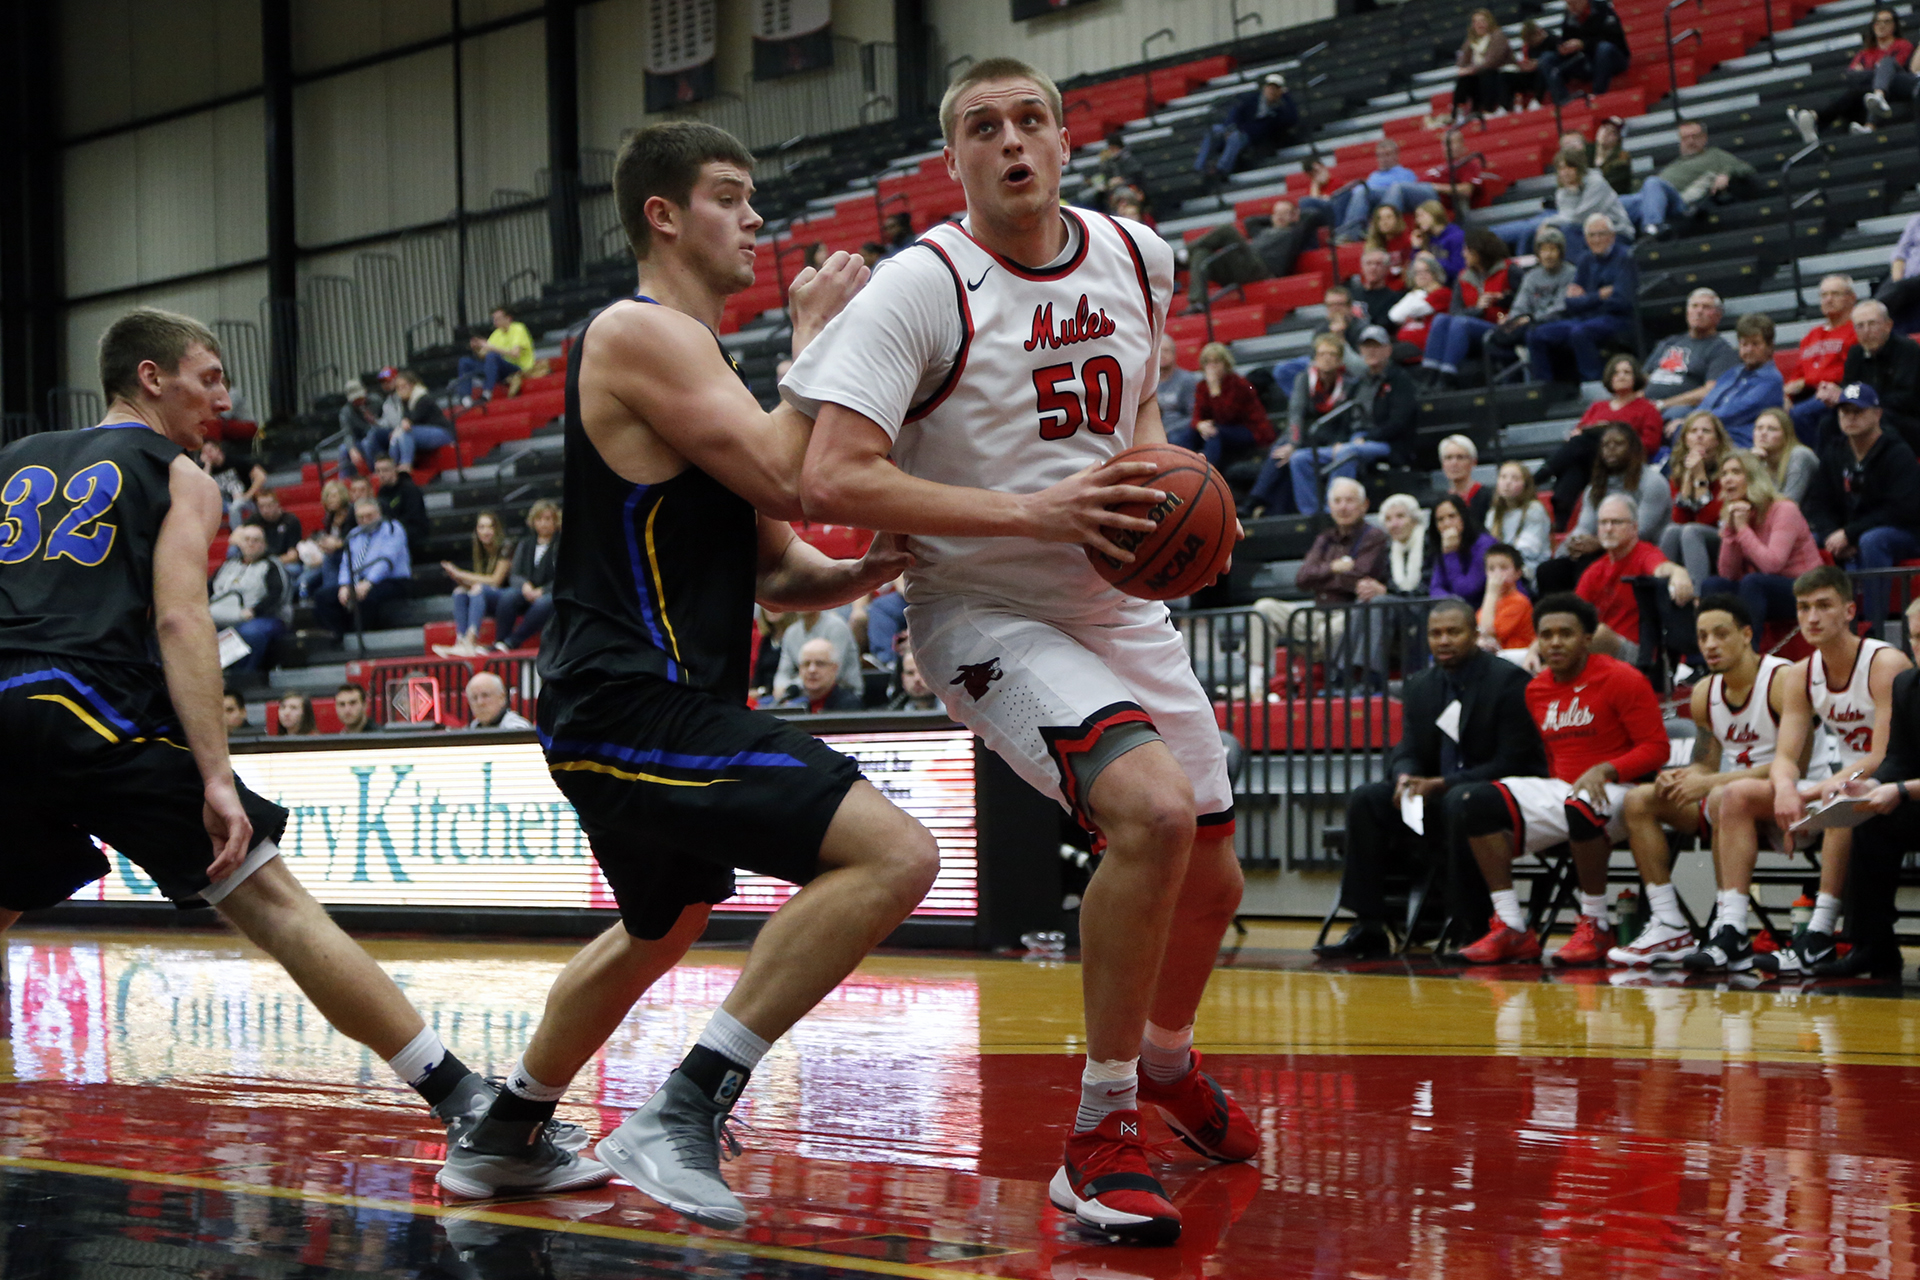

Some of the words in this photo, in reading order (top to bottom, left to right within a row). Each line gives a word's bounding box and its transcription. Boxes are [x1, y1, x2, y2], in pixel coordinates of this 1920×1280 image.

[1023, 293, 1116, 351] Mules
[1032, 354, 1123, 441] 50
[0, 459, 123, 567] 32
[1144, 533, 1206, 592] NCAA
[1541, 696, 1594, 731] Mules
[347, 761, 586, 883] Kitchen
